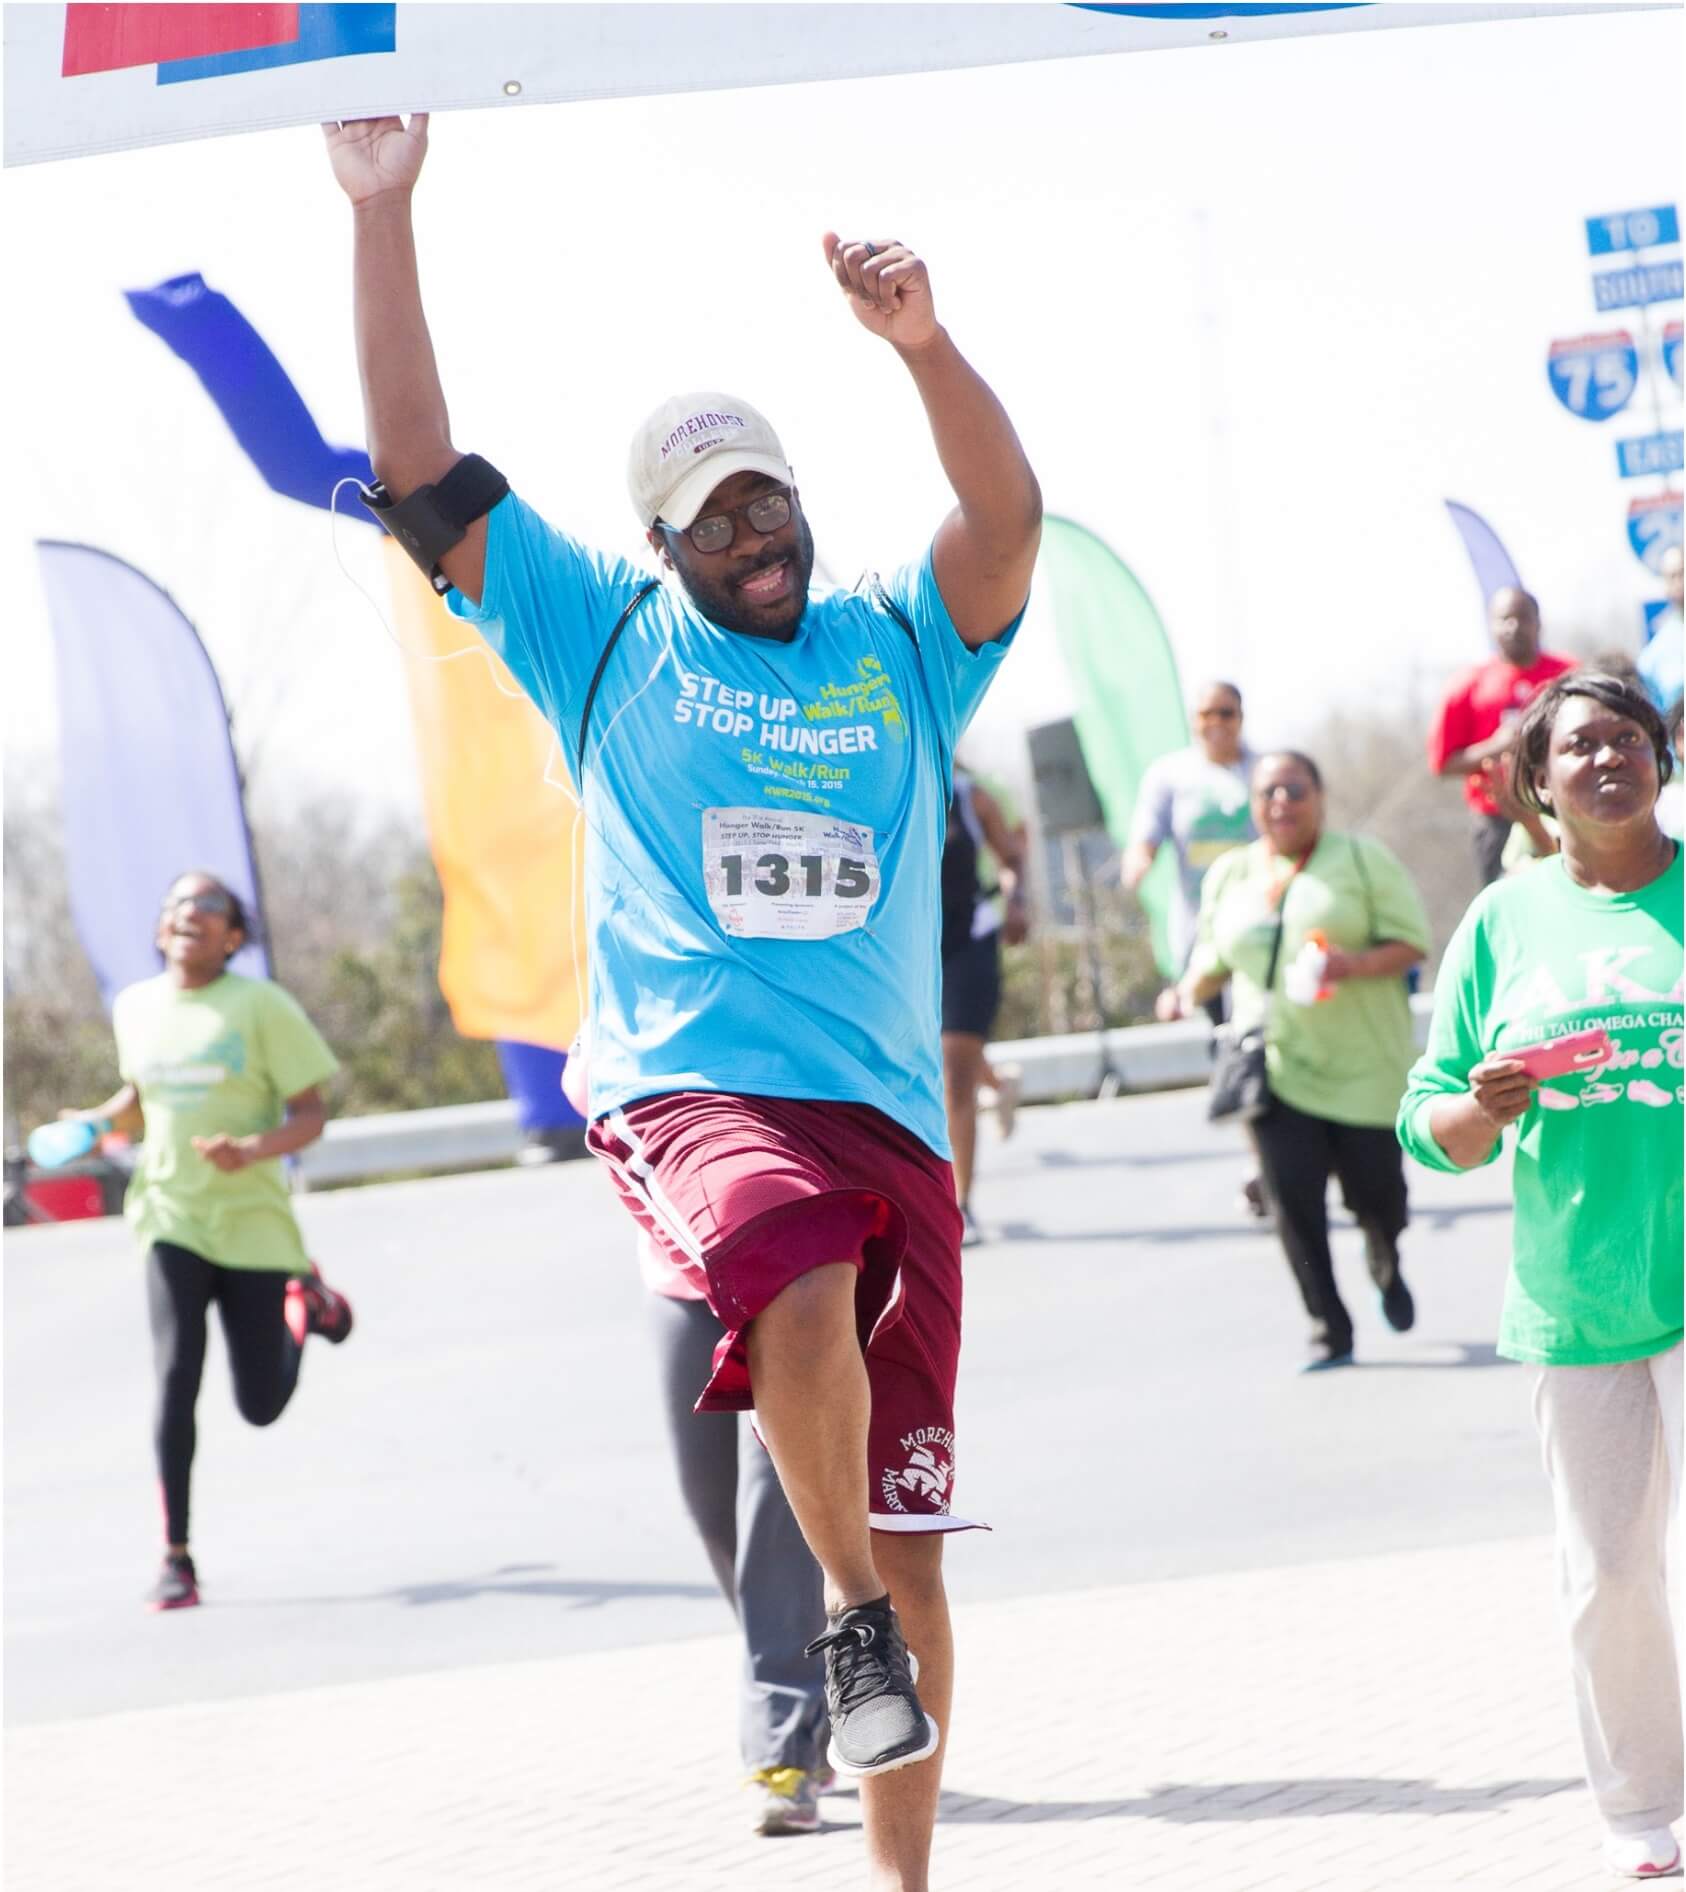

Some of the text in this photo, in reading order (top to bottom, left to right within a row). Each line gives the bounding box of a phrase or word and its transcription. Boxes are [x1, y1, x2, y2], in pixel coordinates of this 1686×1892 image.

[1604, 212, 1661, 250] TO
[1554, 350, 1635, 412] 75
[660, 413, 745, 459] MOREHOUSE
[680, 672, 796, 721] STEP UP
[819, 674, 892, 699] Hunger
[803, 695, 891, 721] Walk/Run
[674, 699, 878, 755] STOP HUNGER
[742, 747, 762, 764] 5K
[768, 755, 850, 779] Walk/Run
[821, 780, 843, 789] 2015
[751, 820, 791, 832] Walk/Run
[720, 853, 871, 898] 1315
[1550, 1019, 1582, 1037] TAU
[1584, 1014, 1646, 1032] OMEGA
